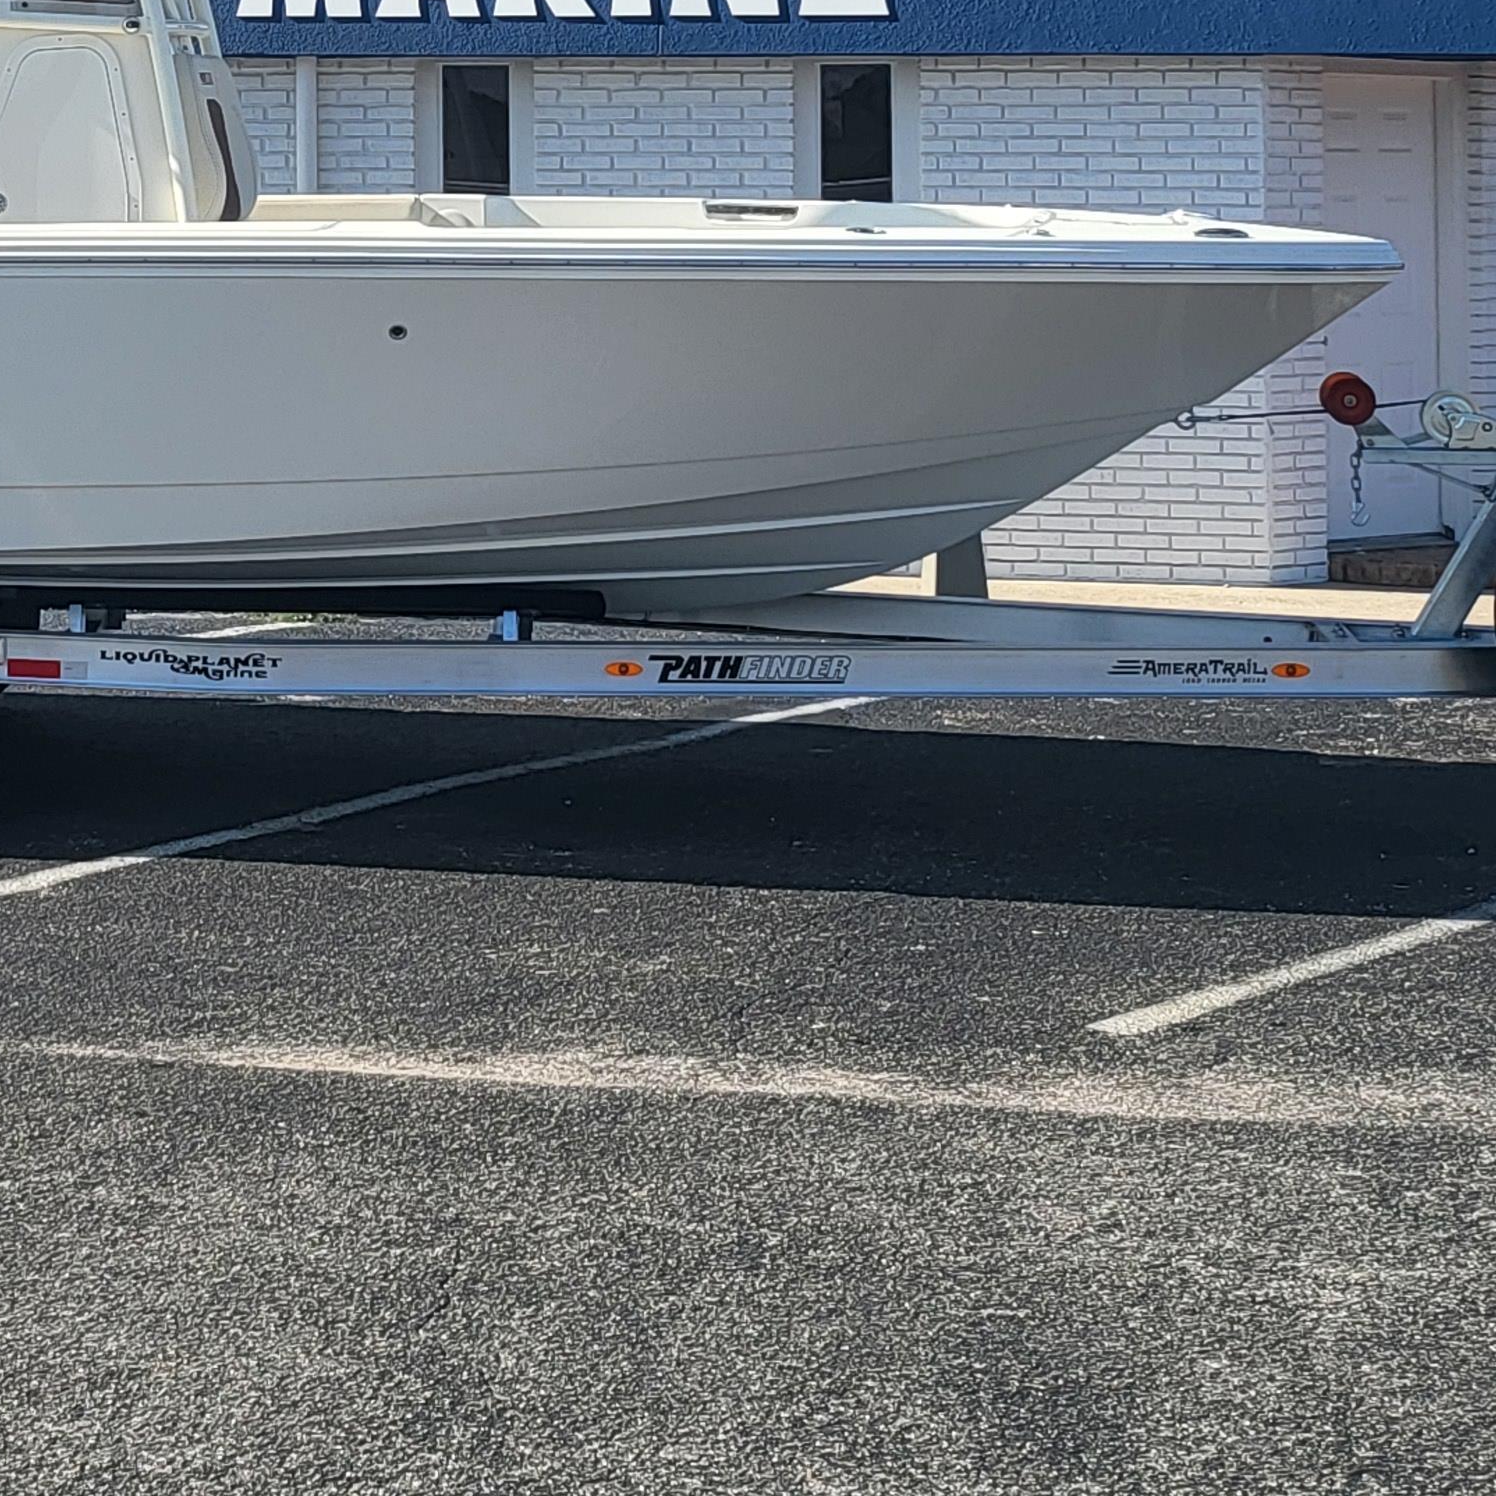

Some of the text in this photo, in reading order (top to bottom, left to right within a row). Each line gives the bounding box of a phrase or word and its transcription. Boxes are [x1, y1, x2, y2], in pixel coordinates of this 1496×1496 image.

[99, 648, 283, 668] LIQUID PLANET
[648, 654, 853, 684] PATHFINDER
